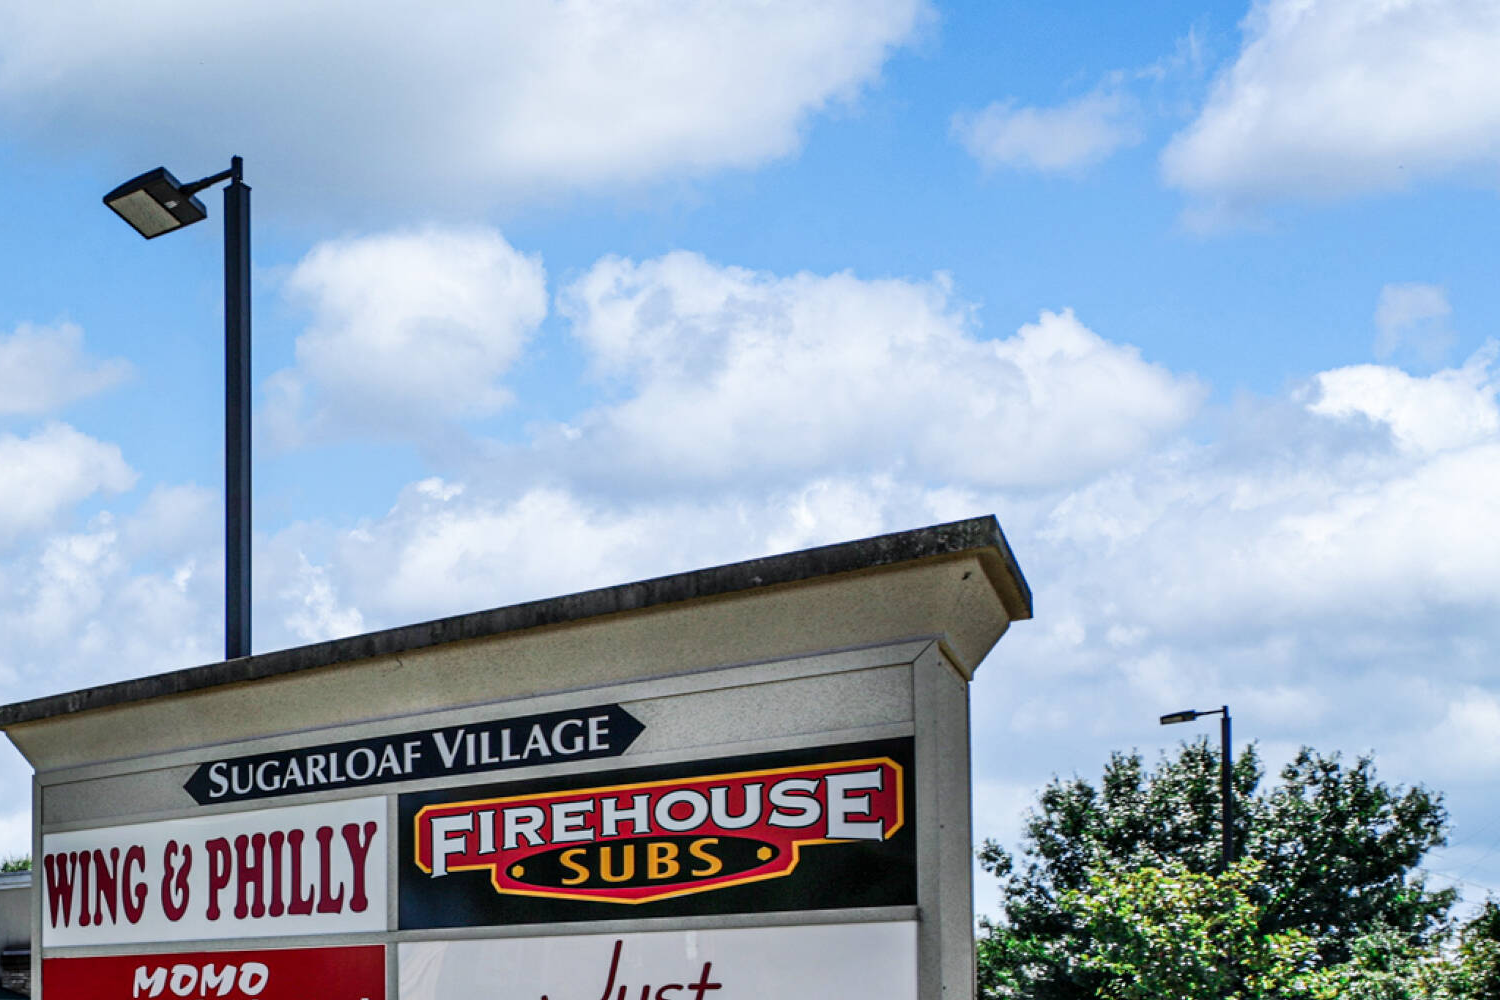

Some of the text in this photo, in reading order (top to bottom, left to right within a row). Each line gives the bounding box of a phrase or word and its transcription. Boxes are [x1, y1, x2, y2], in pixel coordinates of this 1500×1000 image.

[208, 714, 610, 799] SUGARLOAF VILLAGE
[430, 765, 884, 879] FIREHOUSE
[559, 837, 724, 886] SUBS
[44, 821, 378, 929] WING & PHILLY
[133, 961, 269, 999] MOMO
